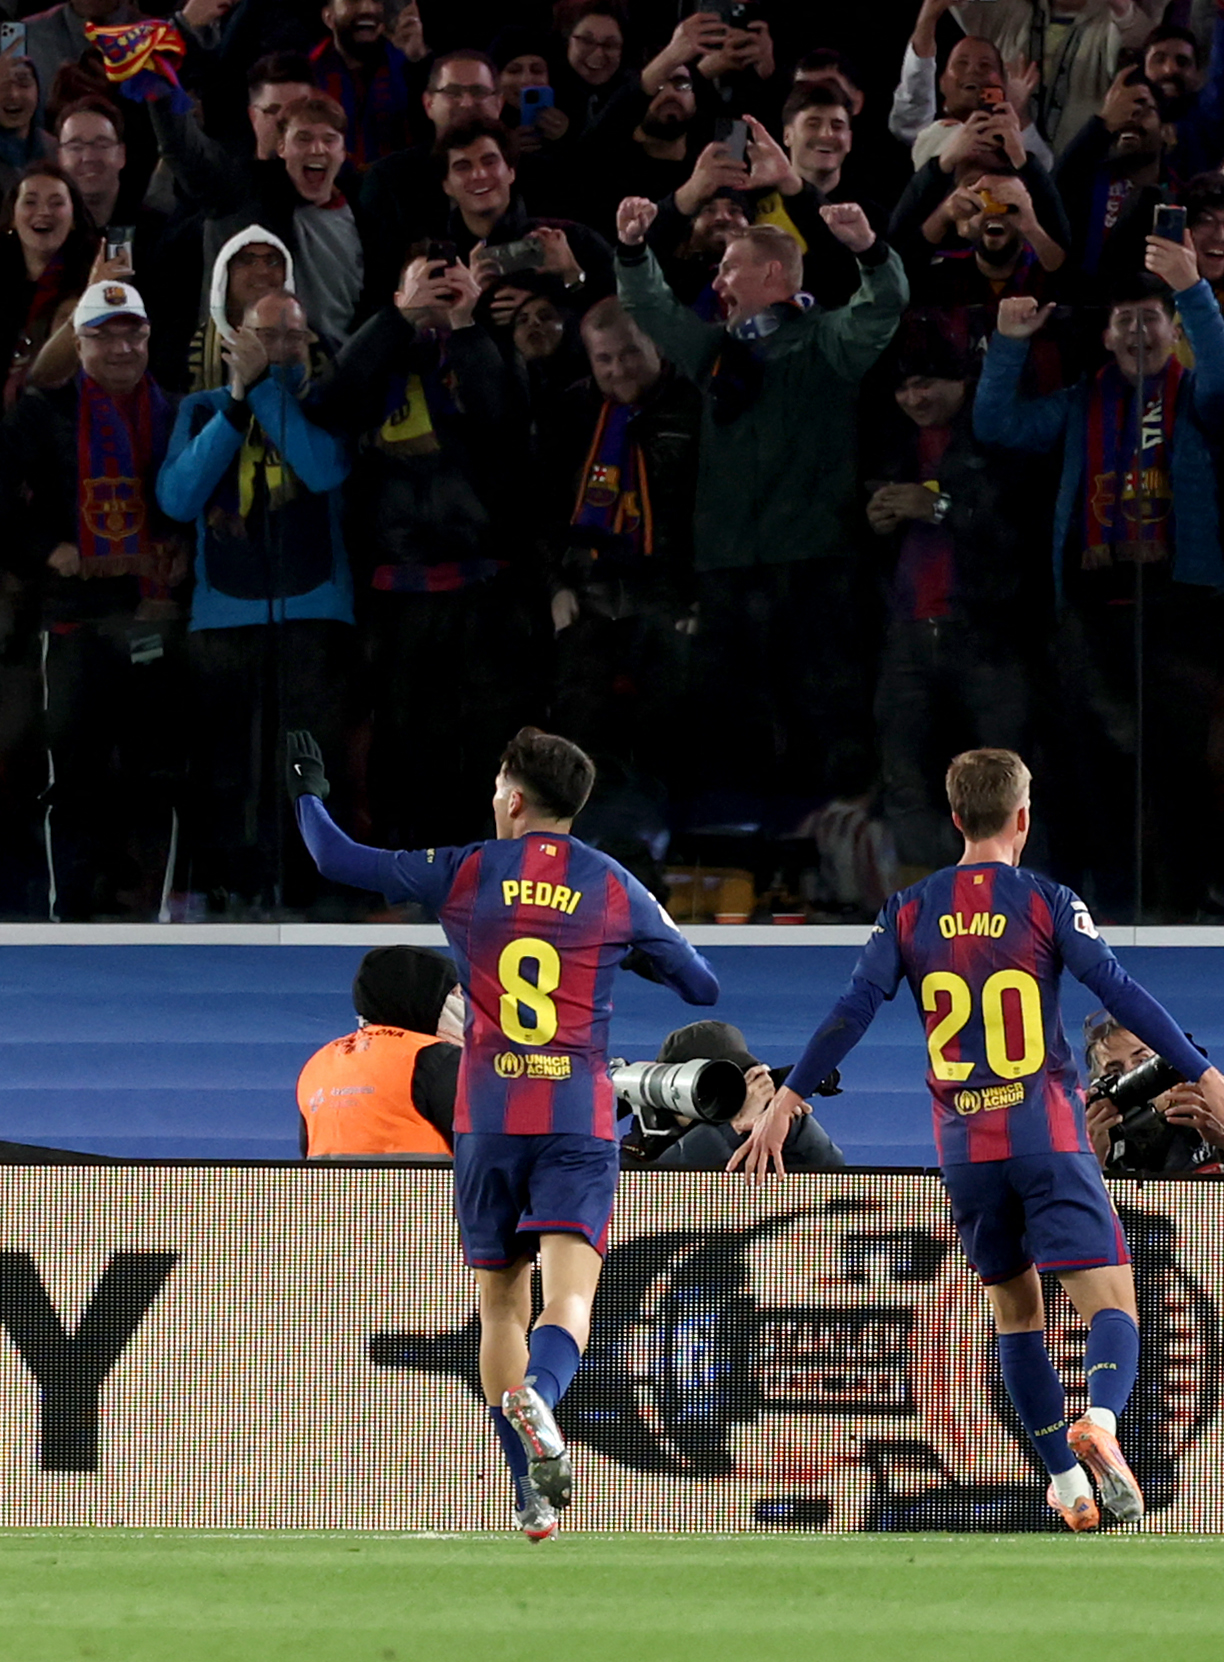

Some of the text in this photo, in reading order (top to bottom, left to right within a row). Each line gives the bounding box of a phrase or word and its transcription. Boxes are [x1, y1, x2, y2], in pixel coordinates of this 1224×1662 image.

[502, 879, 582, 914] PEDRI
[938, 912, 1006, 939] OLMO
[498, 937, 561, 1046] 8
[921, 968, 1046, 1082] 20
[525, 1054, 571, 1066] UNHCR
[527, 1065, 571, 1076] ACNUR
[981, 1081, 1024, 1098] UNHCR
[983, 1091, 1024, 1107] ACNUR
